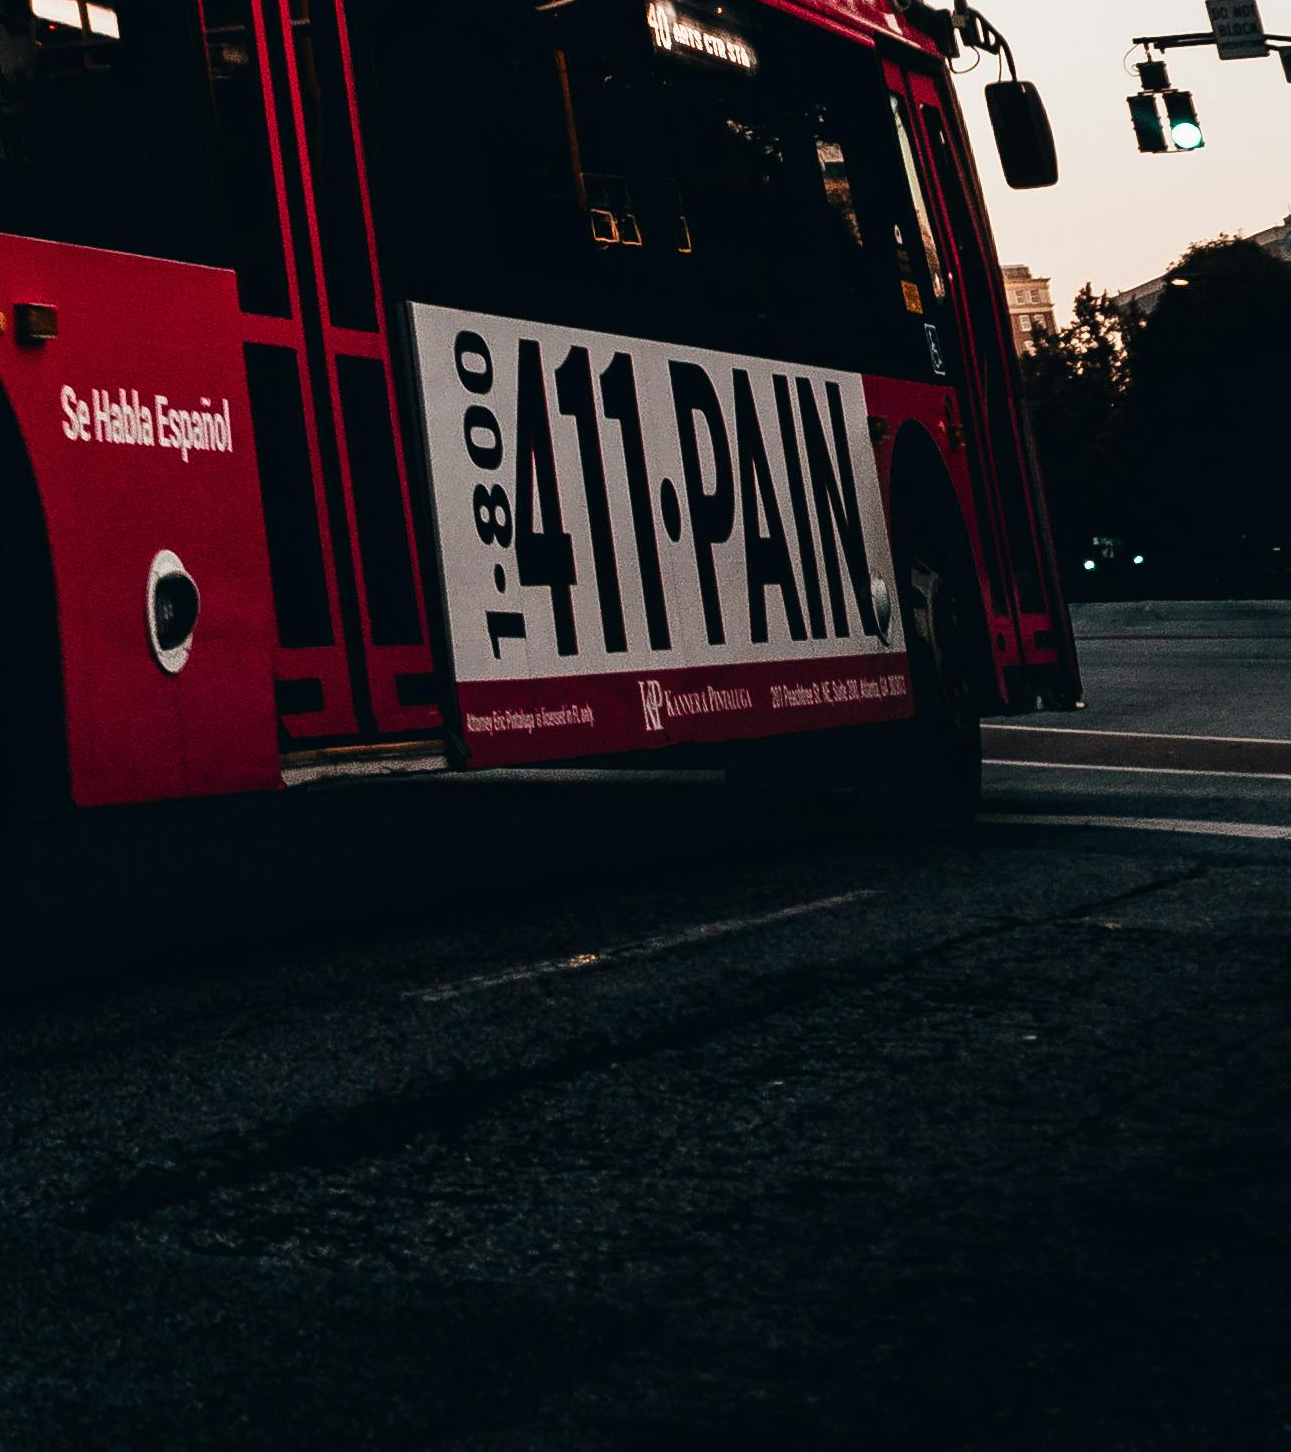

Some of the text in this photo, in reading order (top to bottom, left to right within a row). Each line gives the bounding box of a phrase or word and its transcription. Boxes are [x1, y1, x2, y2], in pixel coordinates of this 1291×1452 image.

[1212, 6, 1228, 20] DO
[1219, 22, 1257, 36] BLOCK
[646, 2, 673, 51] 40
[726, 41, 751, 68] STA
[60, 384, 233, 463] Se Habla Español
